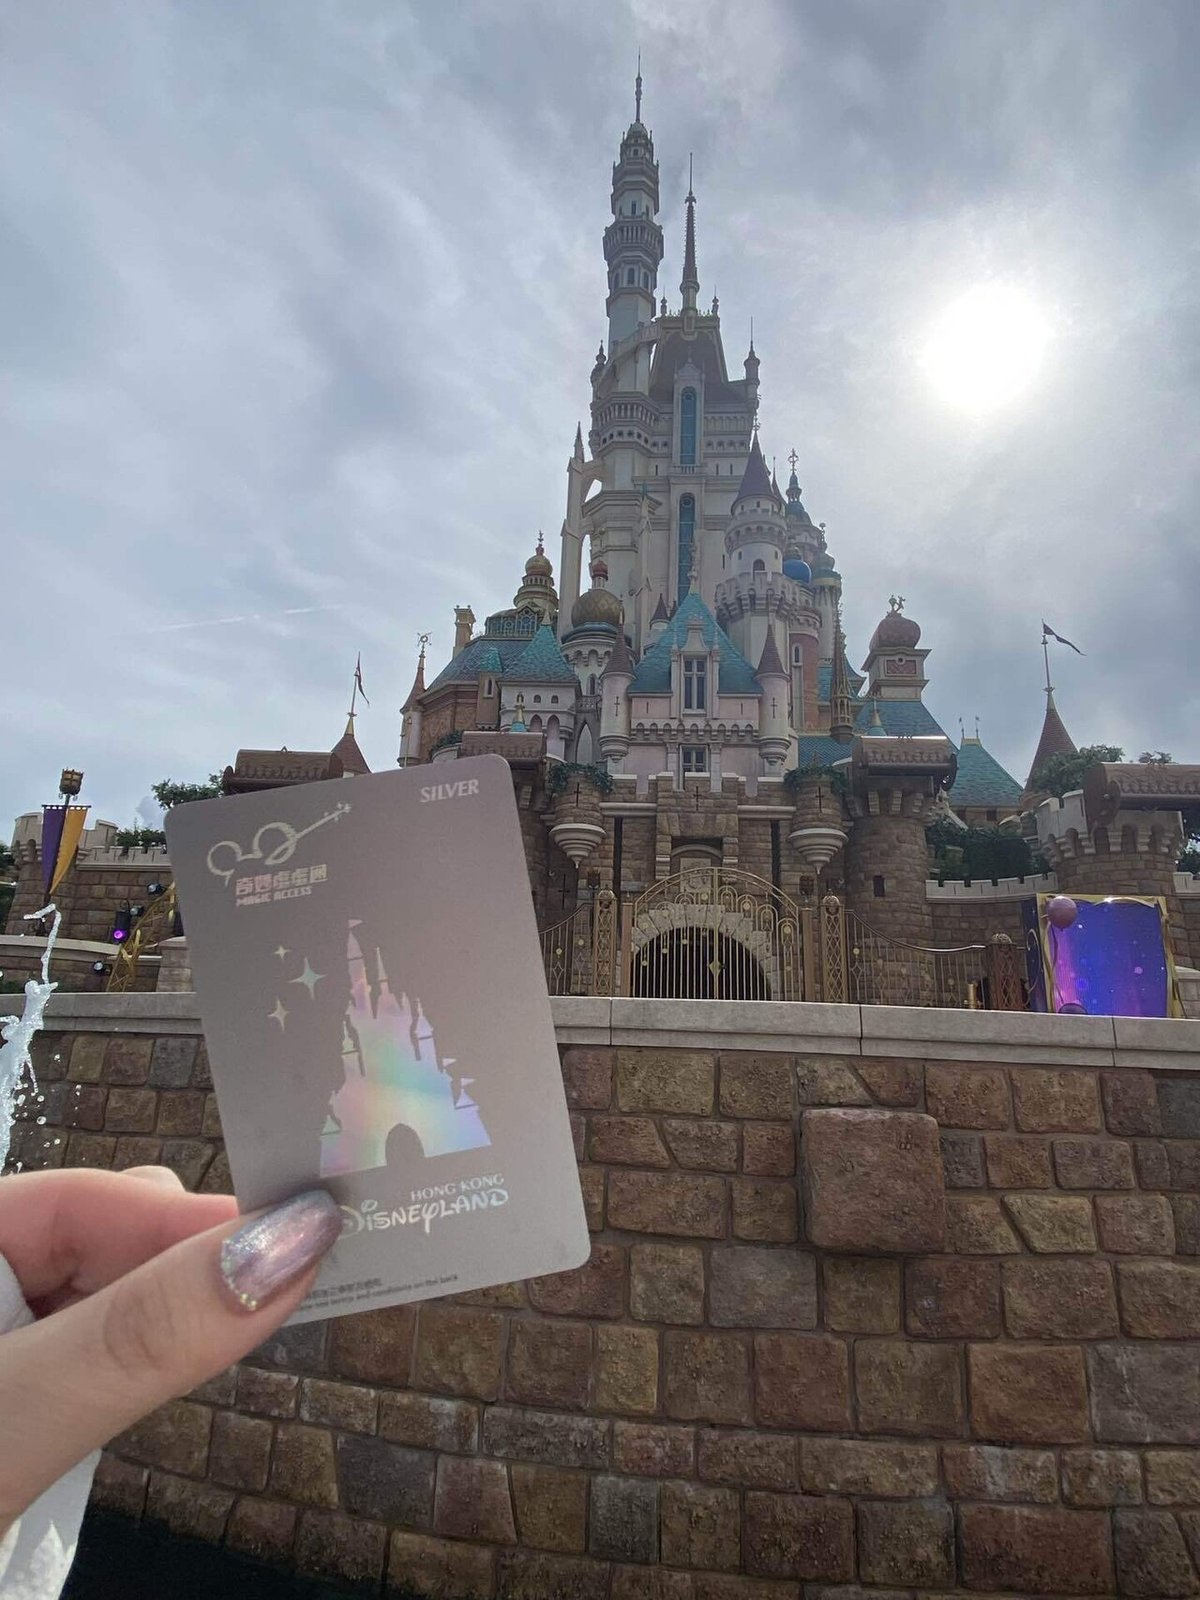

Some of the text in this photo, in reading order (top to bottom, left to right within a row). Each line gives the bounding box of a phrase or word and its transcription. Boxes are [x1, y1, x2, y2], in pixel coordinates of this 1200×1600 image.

[420, 778, 479, 803] SILVER
[273, 885, 312, 901] ACCESS
[411, 1173, 505, 1202] HONG KONG
